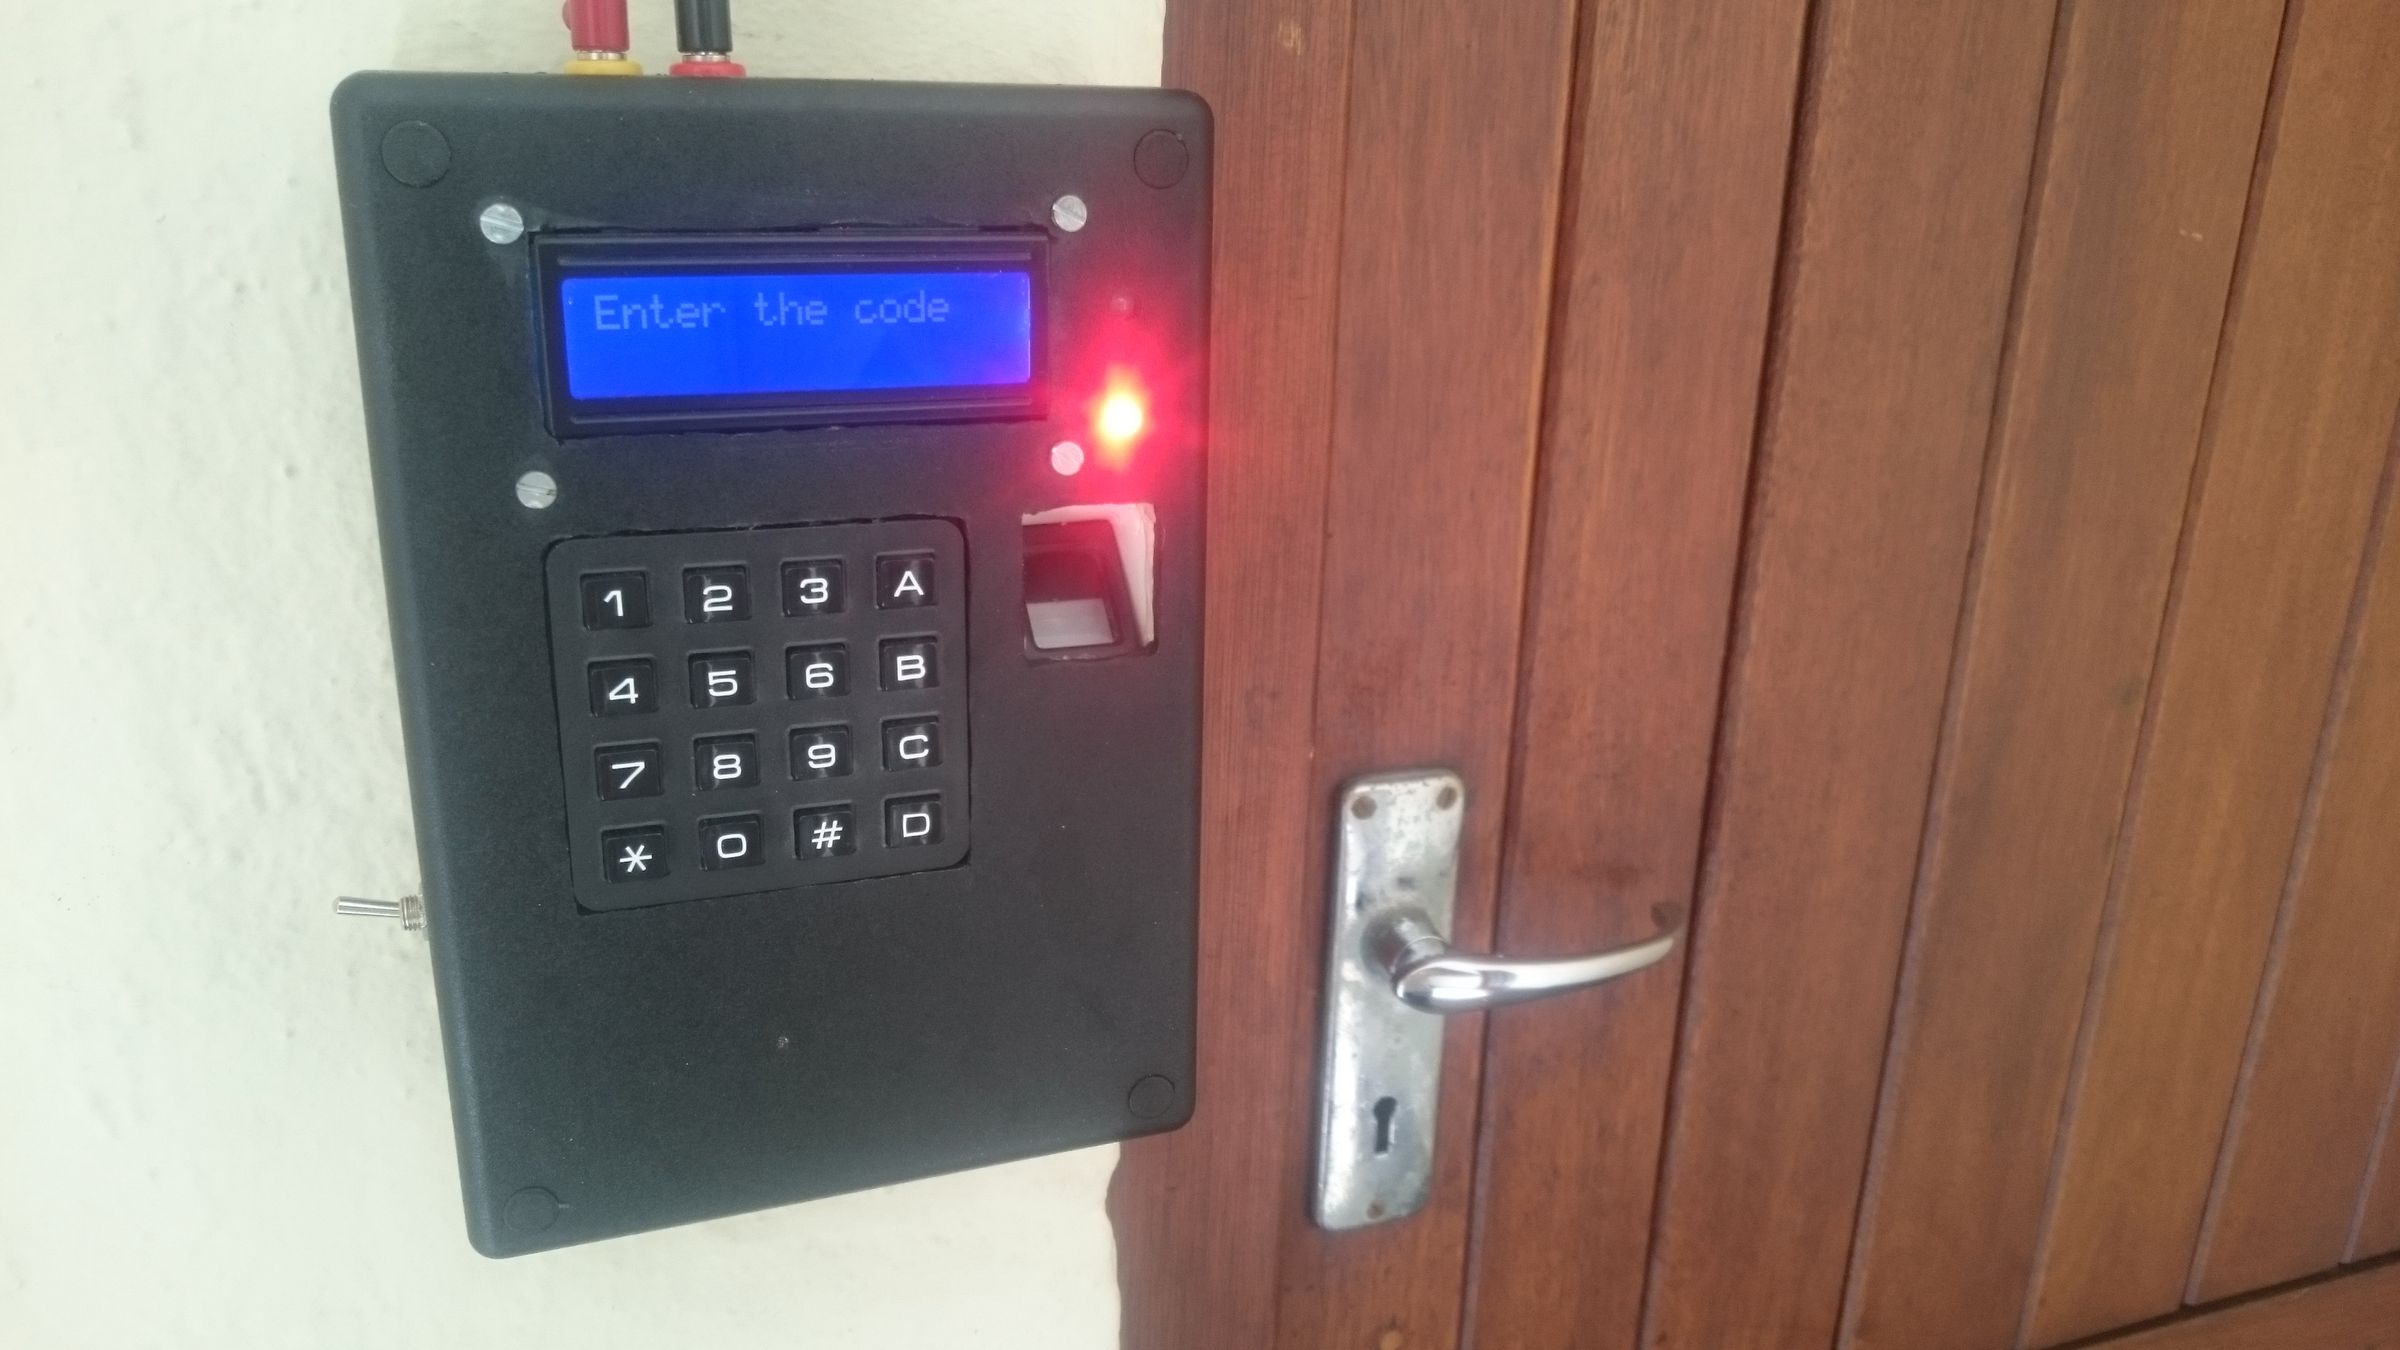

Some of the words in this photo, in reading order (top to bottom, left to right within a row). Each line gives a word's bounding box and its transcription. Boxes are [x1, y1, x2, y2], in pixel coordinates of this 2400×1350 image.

[594, 294, 727, 331] Enter
[754, 292, 829, 327] the
[854, 290, 951, 324] code
[603, 589, 624, 617] 1
[702, 585, 733, 613] 2
[799, 577, 829, 604] 3
[893, 570, 925, 598] A
[608, 677, 639, 704] 4
[707, 669, 738, 697] 5
[805, 662, 834, 689] 6
[896, 654, 927, 682] B
[611, 761, 645, 789] 7
[712, 753, 742, 780] 8
[807, 743, 836, 769] 9
[899, 734, 930, 760] C
[716, 833, 747, 859] 0
[811, 820, 843, 850] #
[902, 812, 931, 838] D
